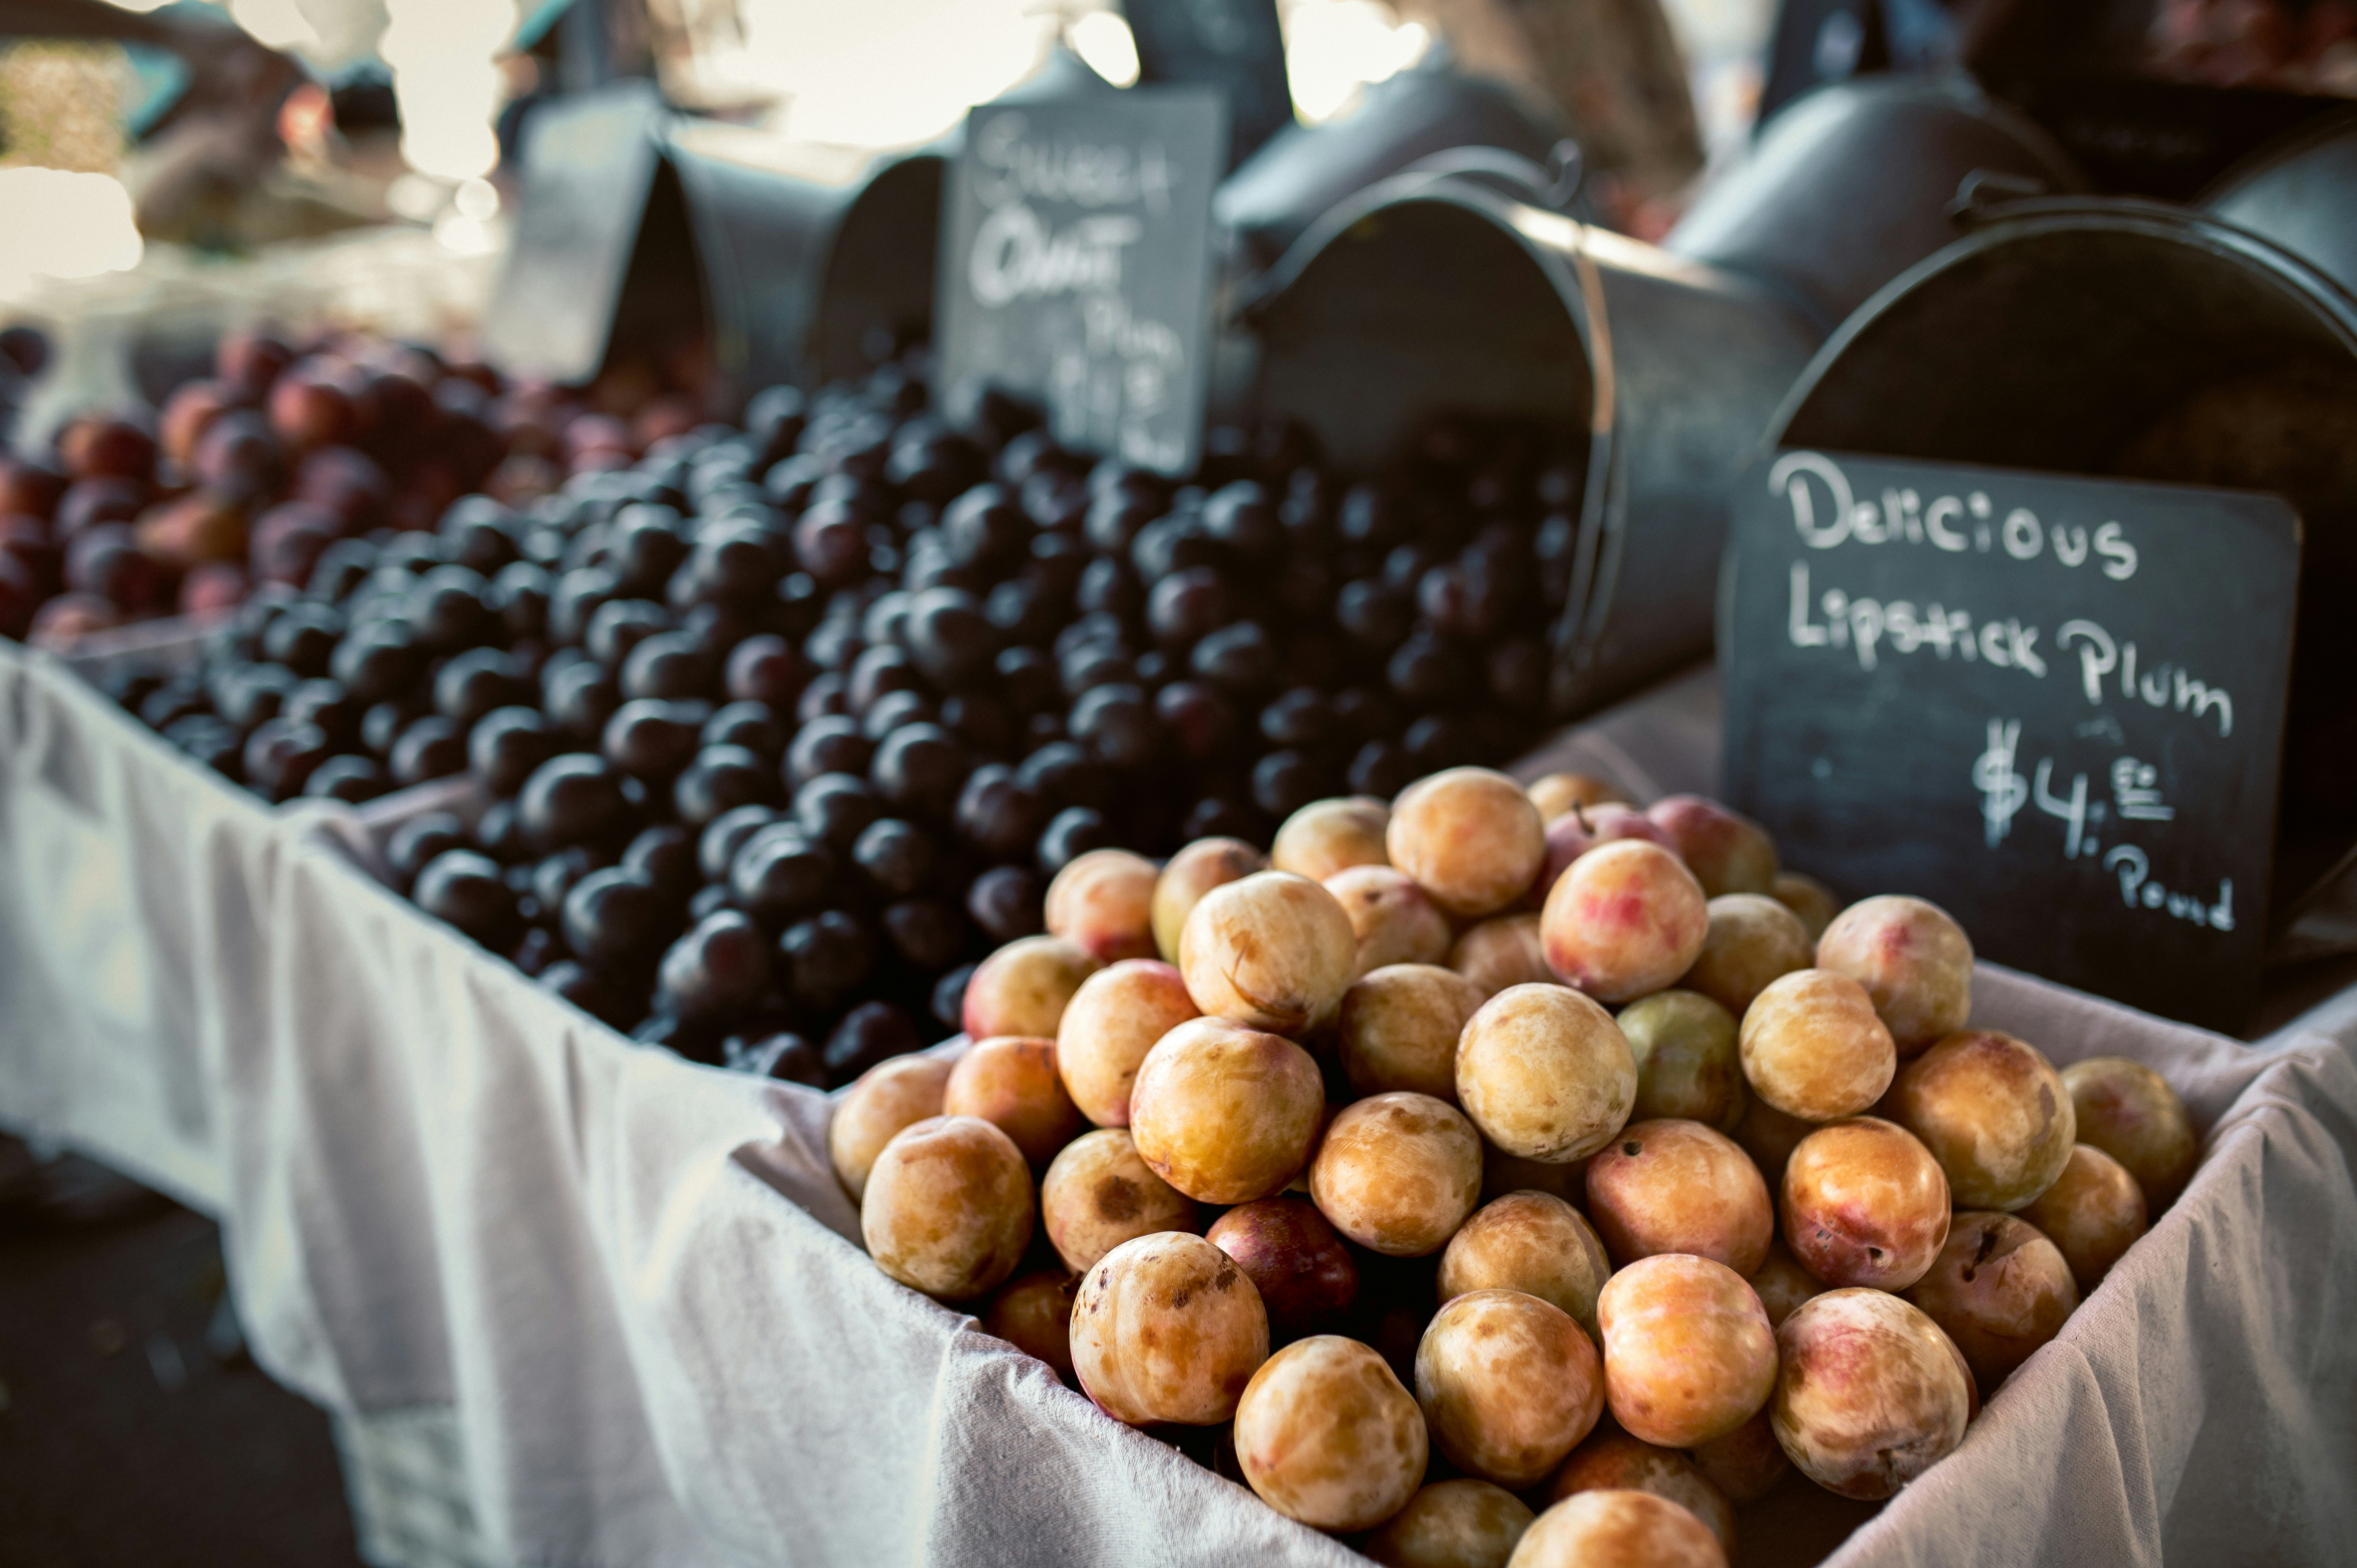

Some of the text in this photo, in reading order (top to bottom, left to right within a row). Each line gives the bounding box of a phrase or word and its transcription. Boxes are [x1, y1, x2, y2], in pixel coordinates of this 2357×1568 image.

[1769, 453, 2137, 580] Delicious
[1788, 562, 2234, 737] Lipstick Plum
[2106, 845, 2235, 932] Pound
